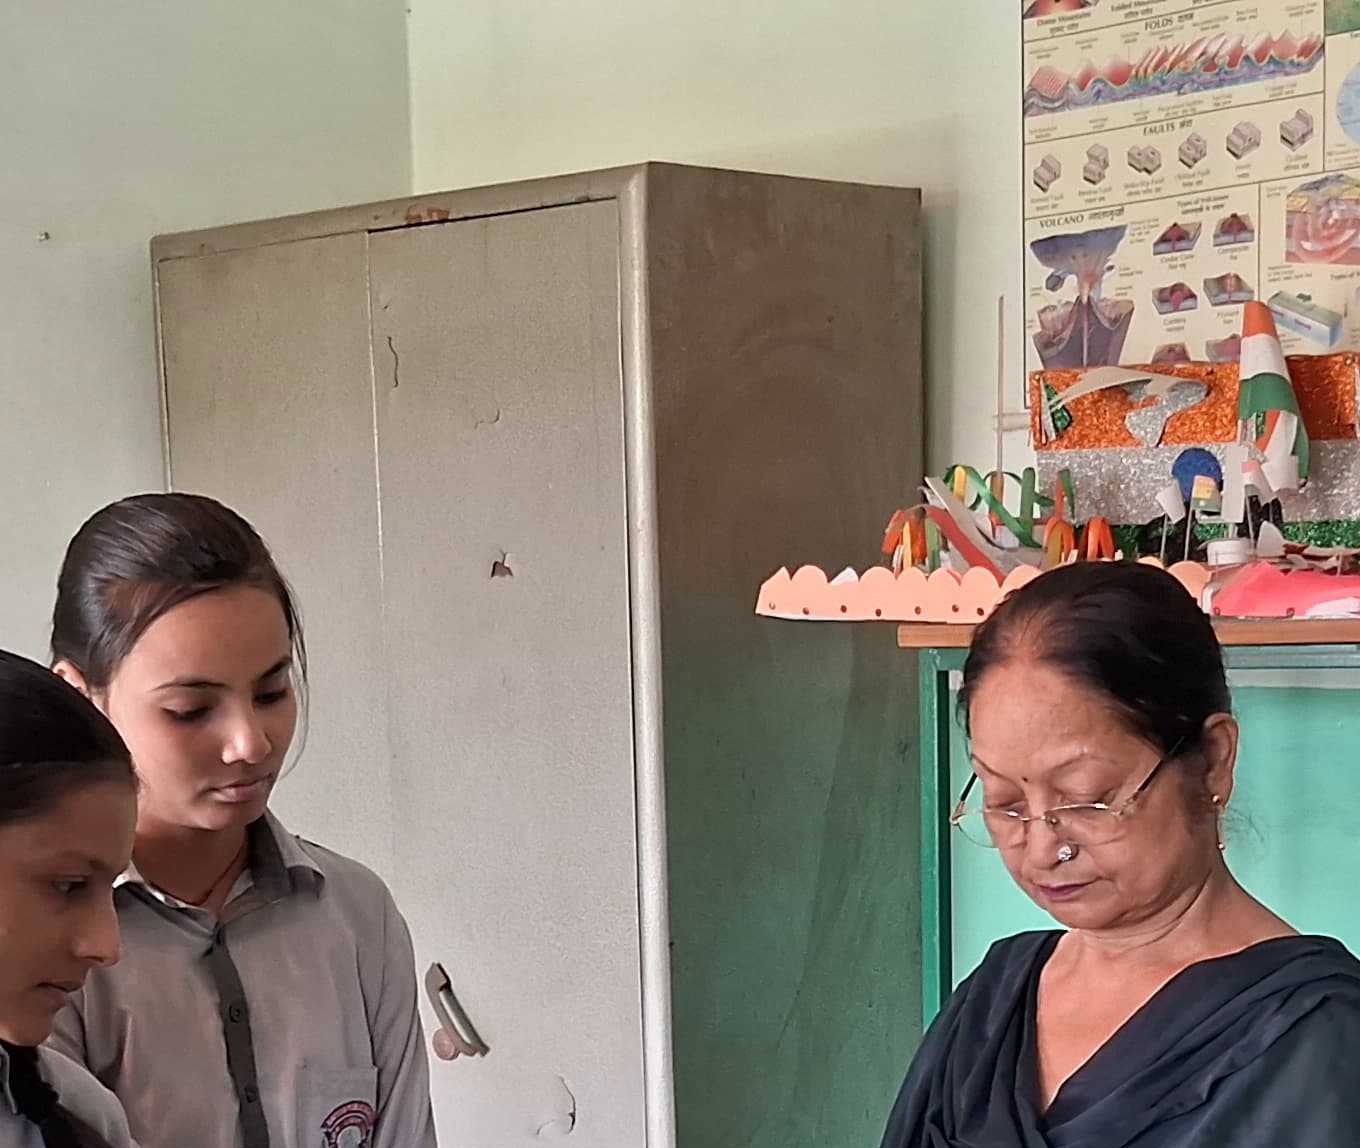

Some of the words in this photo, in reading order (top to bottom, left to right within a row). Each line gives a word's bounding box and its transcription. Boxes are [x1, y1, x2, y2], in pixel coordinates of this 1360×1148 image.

[1144, 18, 1173, 31] FOLDS
[1143, 123, 1175, 137] FAULTS
[1040, 215, 1084, 229] VOLCANO
